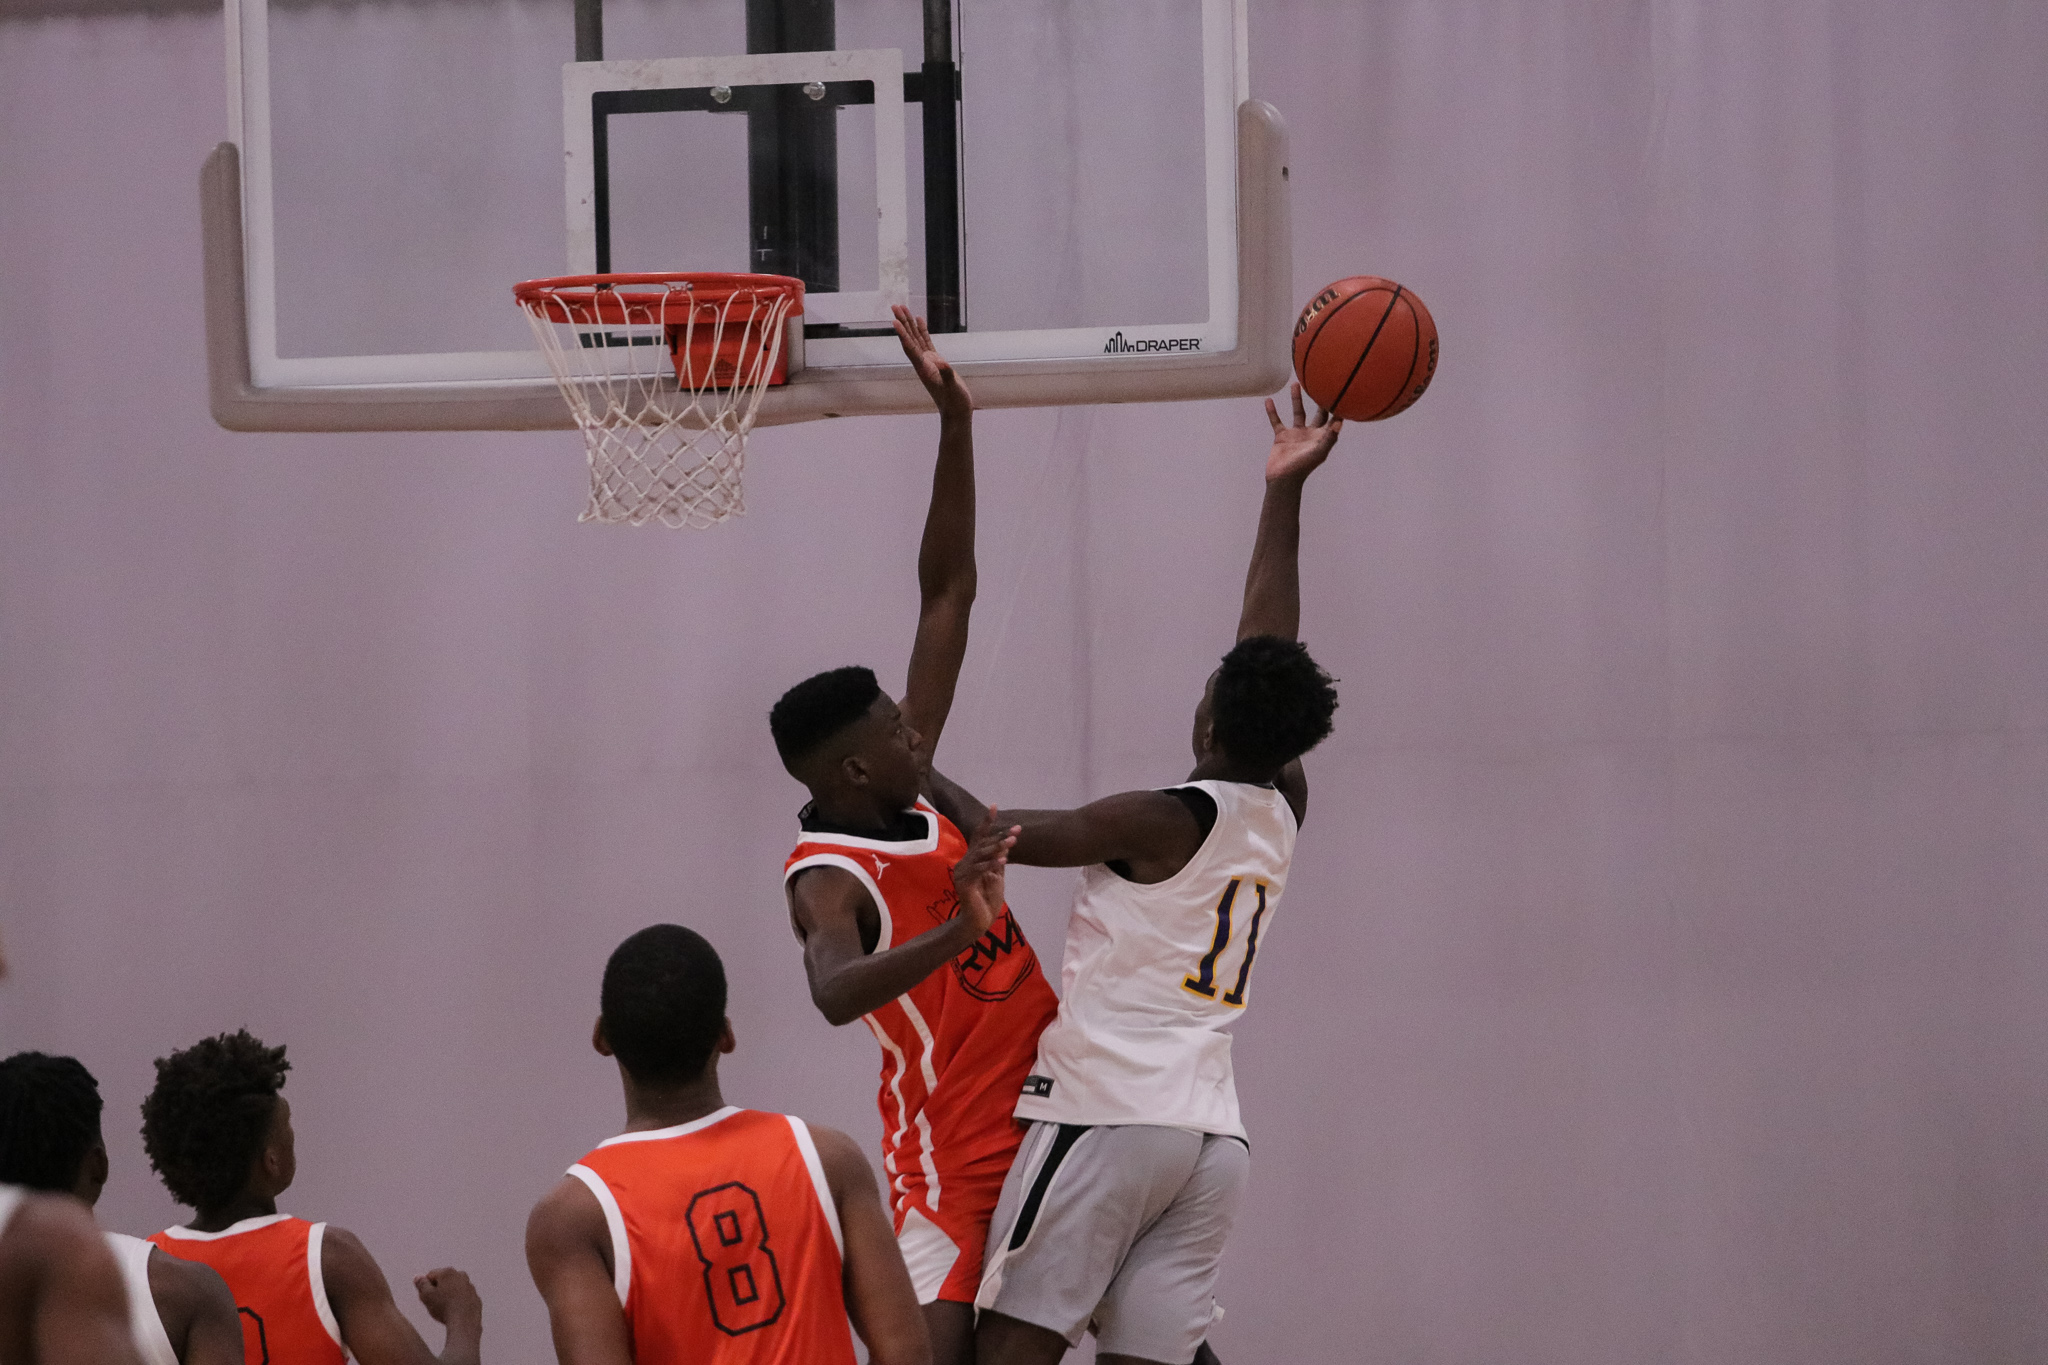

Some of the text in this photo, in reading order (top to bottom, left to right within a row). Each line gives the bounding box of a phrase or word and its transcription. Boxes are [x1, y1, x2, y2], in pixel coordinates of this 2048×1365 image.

[1136, 338, 1200, 352] DRAPER
[1181, 875, 1268, 1008] 11
[1039, 1082, 1048, 1092] M
[685, 1181, 786, 1337] 8
